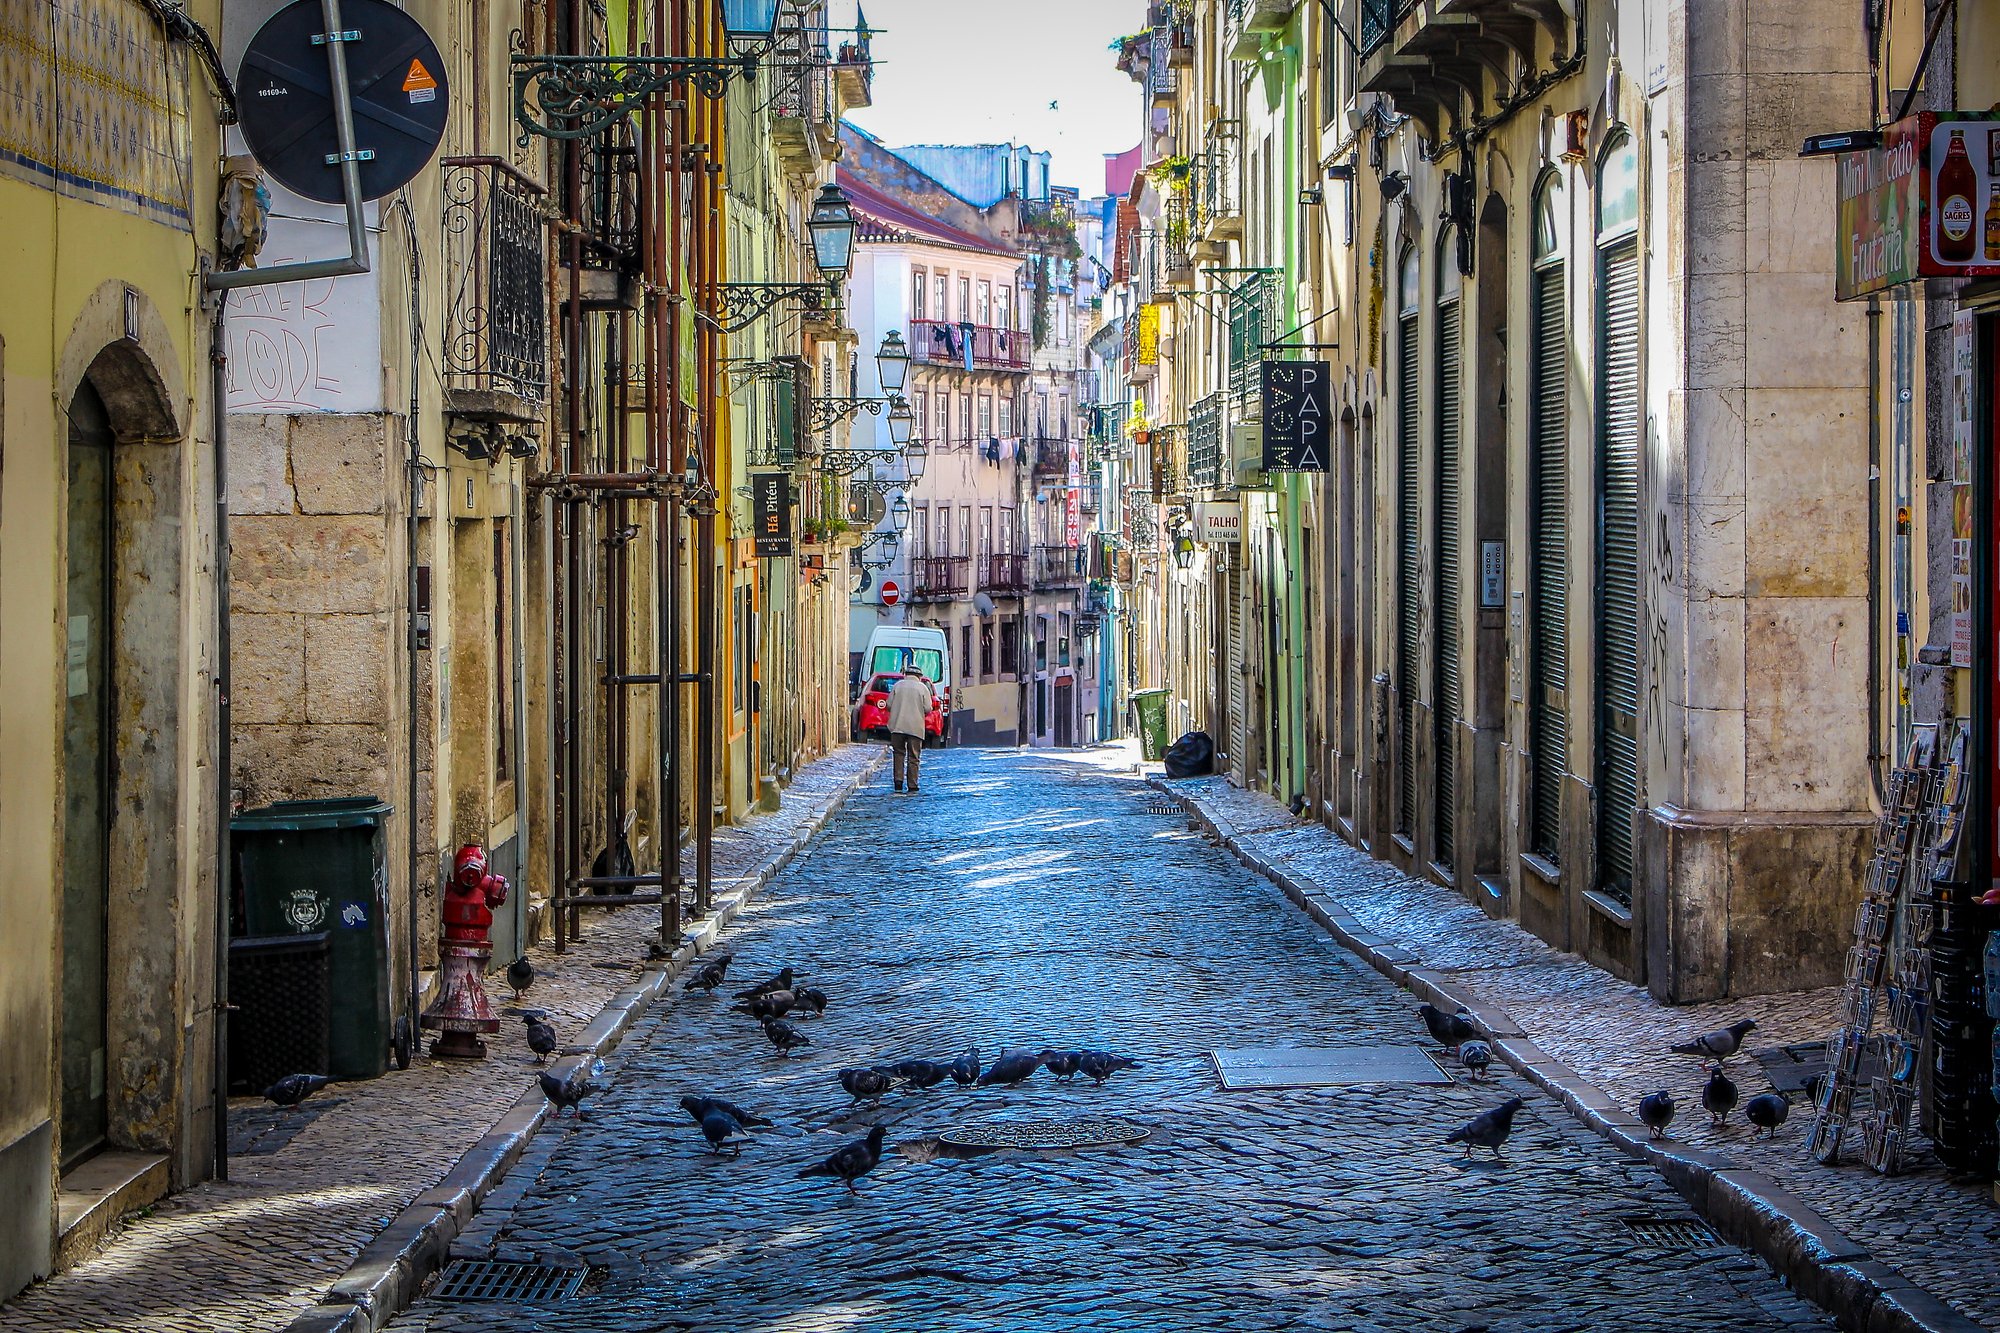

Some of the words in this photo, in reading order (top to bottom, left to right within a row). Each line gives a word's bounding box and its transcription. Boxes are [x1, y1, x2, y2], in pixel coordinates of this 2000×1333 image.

[258, 88, 288, 97] 16169-A
[1842, 154, 1865, 202] Mini
[1866, 132, 1913, 193] Mercado
[1944, 211, 1971, 220] SAGRES
[1852, 217, 1902, 286] Frutaria
[1299, 368, 1321, 468] PAPA
[765, 480, 778, 513] Pitéu
[767, 515, 778, 533] Há
[1207, 516, 1239, 528] TALHO
